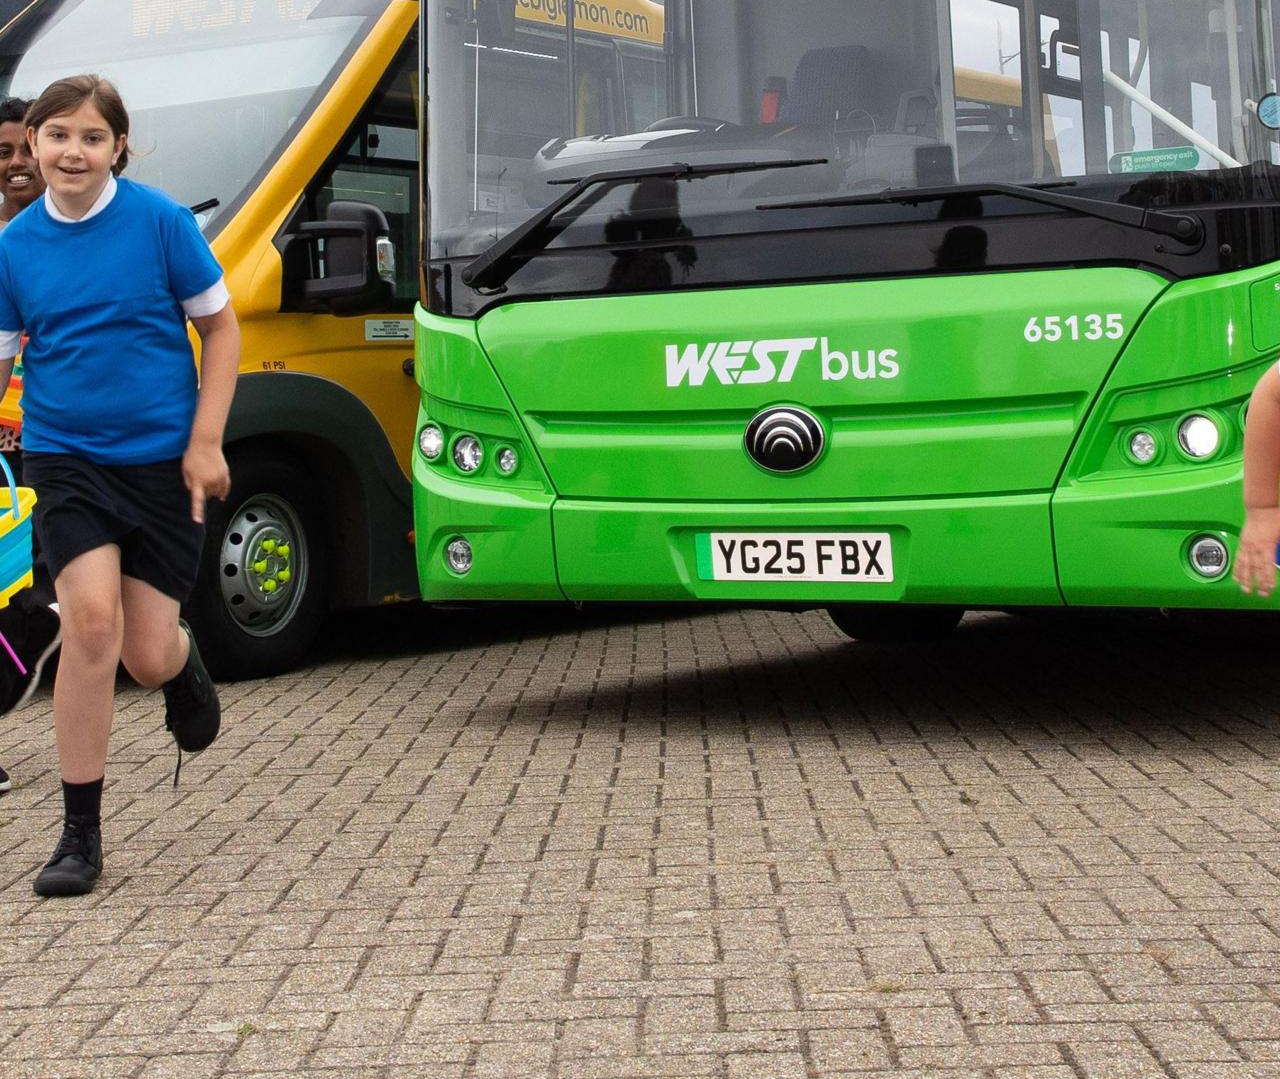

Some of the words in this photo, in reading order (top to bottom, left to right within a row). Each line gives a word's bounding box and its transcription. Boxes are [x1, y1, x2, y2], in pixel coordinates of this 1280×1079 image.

[1134, 151, 1178, 163] emergency
[1178, 151, 1194, 159] exit
[1023, 313, 1124, 343] 65135
[262, 361, 271, 370] 61
[273, 361, 286, 370] PSI
[665, 337, 818, 387] WEST
[820, 337, 900, 381] bus
[717, 539, 806, 574] YG25
[815, 540, 885, 575] FBX
